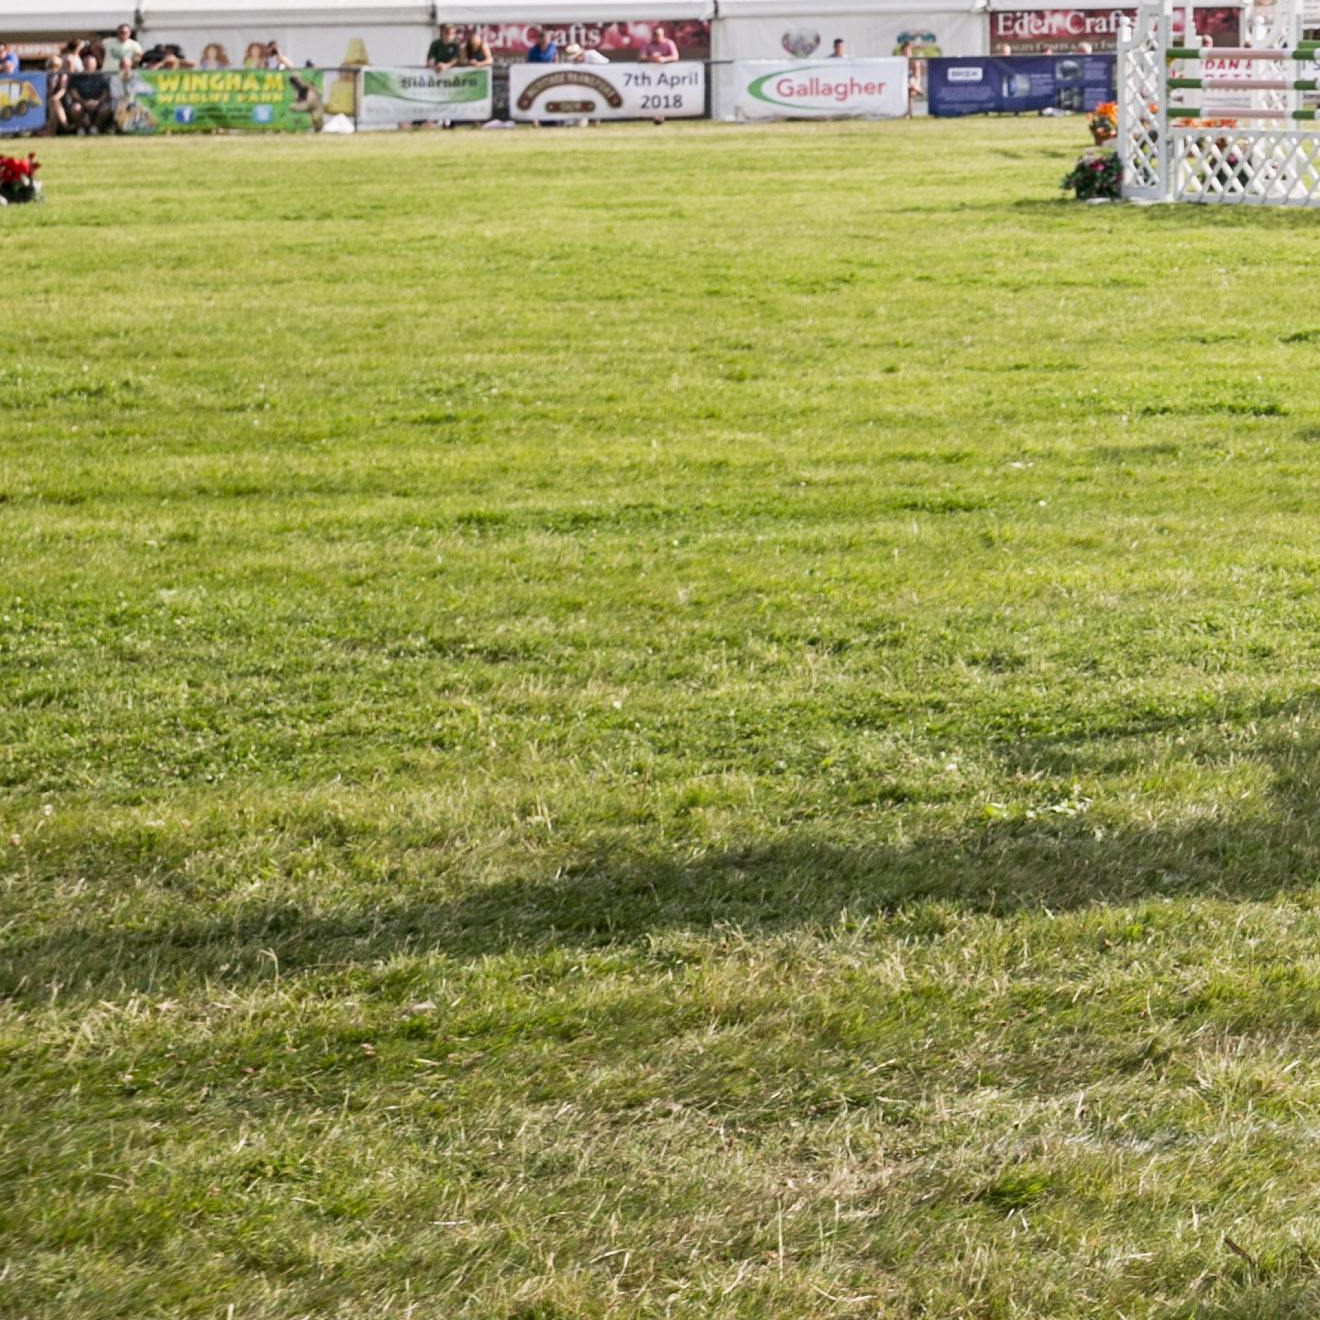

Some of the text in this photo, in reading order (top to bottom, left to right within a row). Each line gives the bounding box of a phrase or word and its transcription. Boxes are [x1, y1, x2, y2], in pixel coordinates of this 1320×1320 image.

[997, 10, 1140, 35] Eden Crafs
[157, 72, 285, 93] WINGHAM
[623, 70, 700, 89] 7th April
[776, 77, 887, 101] Gallagher
[236, 92, 283, 104] PARK
[640, 95, 684, 109] 2018
